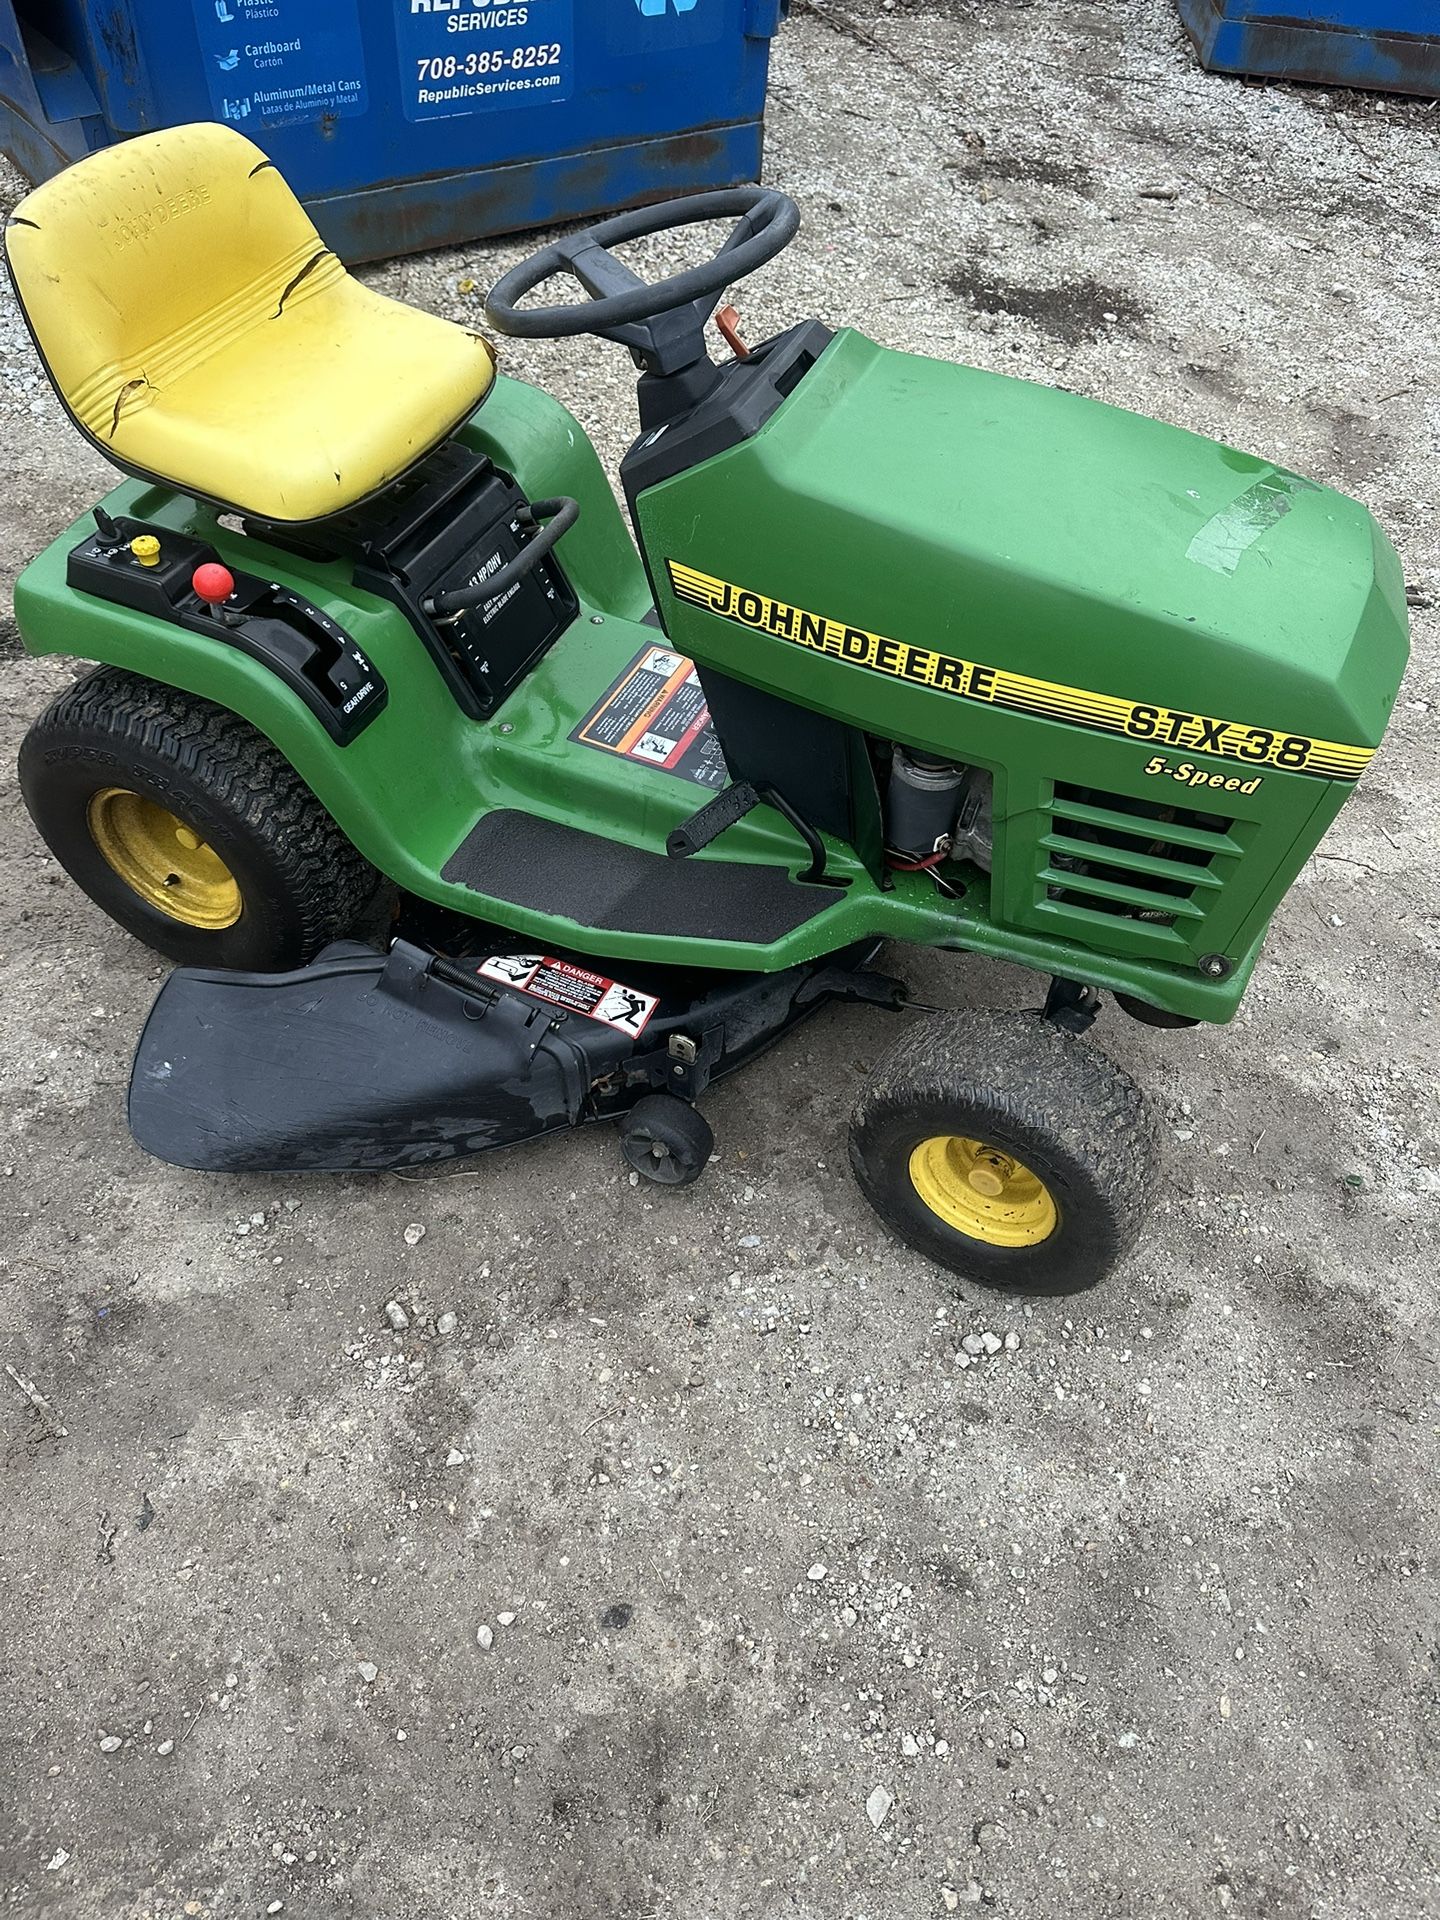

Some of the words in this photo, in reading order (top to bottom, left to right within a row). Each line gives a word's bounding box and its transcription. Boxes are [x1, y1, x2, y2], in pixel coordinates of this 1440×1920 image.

[245, 8, 279, 19] Plástico
[447, 8, 528, 33] SERVICES
[245, 38, 301, 56] Cardboard
[254, 56, 283, 68] Cartón
[417, 43, 561, 81] 708-385-8252
[254, 81, 336, 104] Aluminum/Metal
[338, 80, 361, 91] Cans
[418, 75, 561, 103] RepublicServices.com
[262, 103, 283, 115] Latas
[284, 102, 293, 111] de
[295, 98, 329, 110] Aluminio
[330, 98, 336, 107] y
[336, 93, 358, 104] Metal
[115, 211, 156, 251] JOHN
[153, 184, 212, 224] DEERE
[477, 552, 502, 583] HP/OHV
[305, 607, 315, 616] 2
[322, 620, 331, 629] 3
[338, 636, 346, 644] 4
[710, 583, 827, 650] JOHN
[842, 627, 997, 699] DEERE
[339, 681, 348, 690] 5
[343, 695, 360, 714] GEAR
[356, 681, 374, 700] DRIVE
[1126, 704, 1232, 753] STX
[1239, 729, 1312, 770] 38
[1145, 755, 1263, 796] 5-Speed
[562, 964, 603, 984] DANGER
